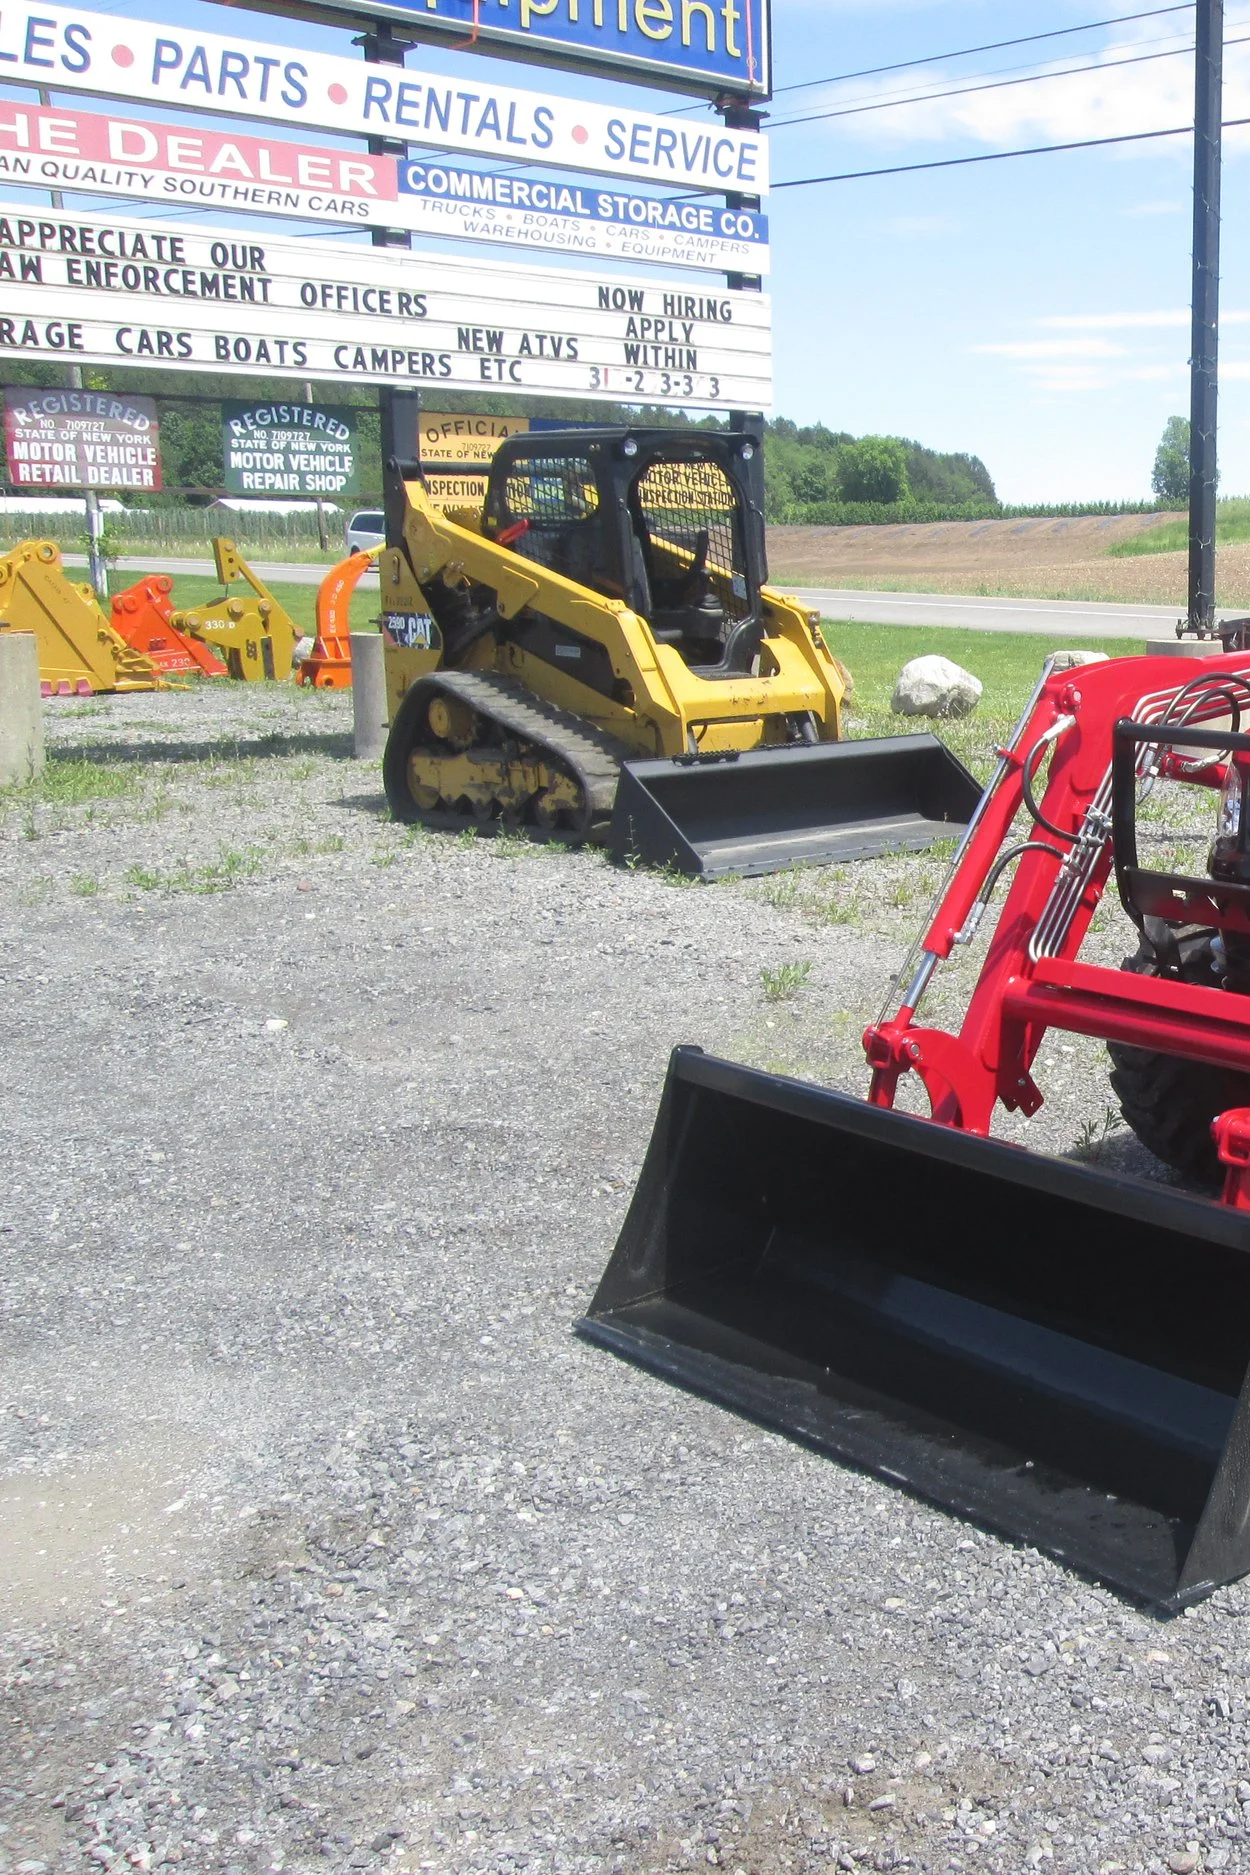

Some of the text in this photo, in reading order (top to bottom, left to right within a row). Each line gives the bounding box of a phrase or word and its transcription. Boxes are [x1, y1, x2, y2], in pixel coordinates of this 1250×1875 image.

[151, 37, 309, 109] PARTS
[362, 75, 555, 149] RENTALS
[603, 118, 759, 182] SERVICE
[107, 120, 379, 196] DEALER
[40, 160, 156, 190] QUALITY
[162, 176, 300, 209] SOUTHERN
[307, 195, 371, 218] CARS
[406, 165, 760, 239] COMMERCIAL STORAGE CO.
[420, 198, 751, 255] TRUCKS BOATS CARS CAMPERS
[463, 219, 718, 264] WAREHOUSING EQUIPMENT
[0, 217, 267, 272] APPRECIATE OUR
[0, 251, 428, 319] AW ENFORCEMENT OFFICERS
[596, 285, 733, 322] NOW HIRING
[456, 326, 579, 361] NEW ATVS
[625, 315, 695, 345] APPLY
[0, 317, 523, 383] RAGE CARS BOATS CAMPERS ETC
[623, 342, 698, 371] WITHIN
[13, 392, 151, 432] REGISTERED
[39, 419, 106, 432] NO. 7109727
[229, 405, 350, 441] REGISTERED
[15, 428, 152, 445] STATE OF NEW YORK
[231, 438, 352, 453] STATE OF NEW YORK
[253, 429, 311, 441] NO. 7109727
[426, 419, 518, 443] OFFICIA
[13, 441, 157, 466] MOTOR VEHICLE
[230, 451, 353, 473] MOTOR VEHICLE
[421, 448, 453, 458] STATE
[456, 450, 471, 459] OF
[18, 462, 155, 487] RETAIL DEALER
[242, 471, 347, 492] REPAIR SHOP
[425, 480, 485, 497] NSPECTION
[205, 620, 225, 630] 330
[408, 616, 432, 649] CAT
